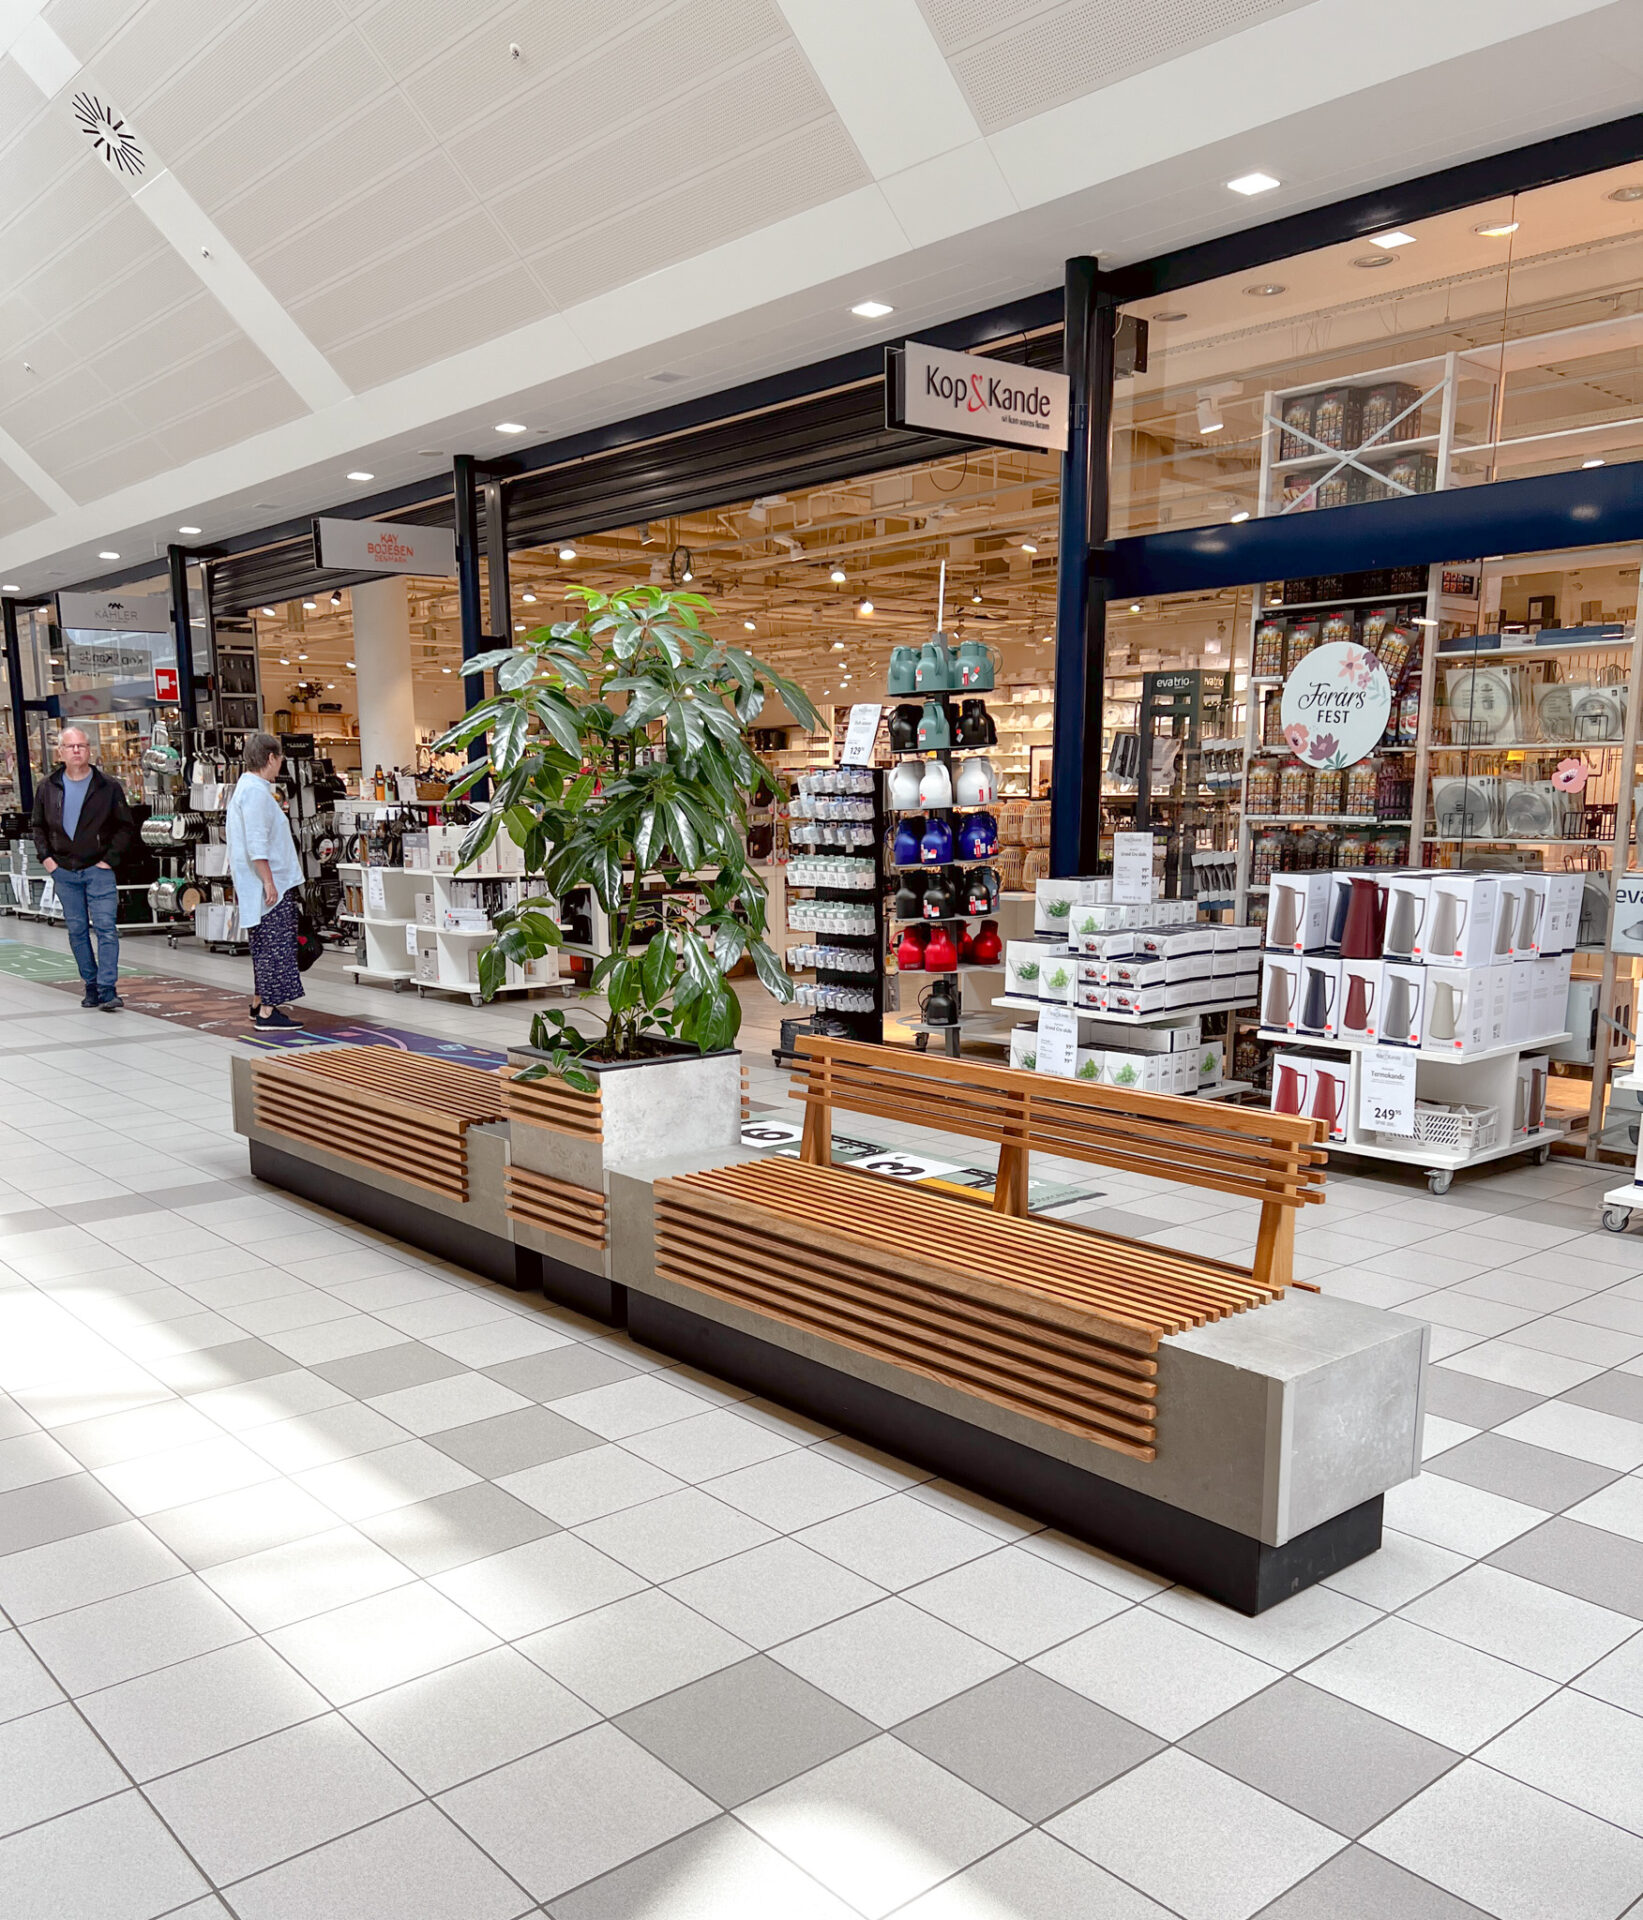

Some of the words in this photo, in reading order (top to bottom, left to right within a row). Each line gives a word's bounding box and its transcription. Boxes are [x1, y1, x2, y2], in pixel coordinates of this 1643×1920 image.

[380, 533, 399, 545] KAY
[367, 543, 414, 556] BOJESEN
[1156, 676, 1190, 688] evatrio
[1316, 710, 1350, 723] FEST
[866, 1162, 925, 1175] 3
